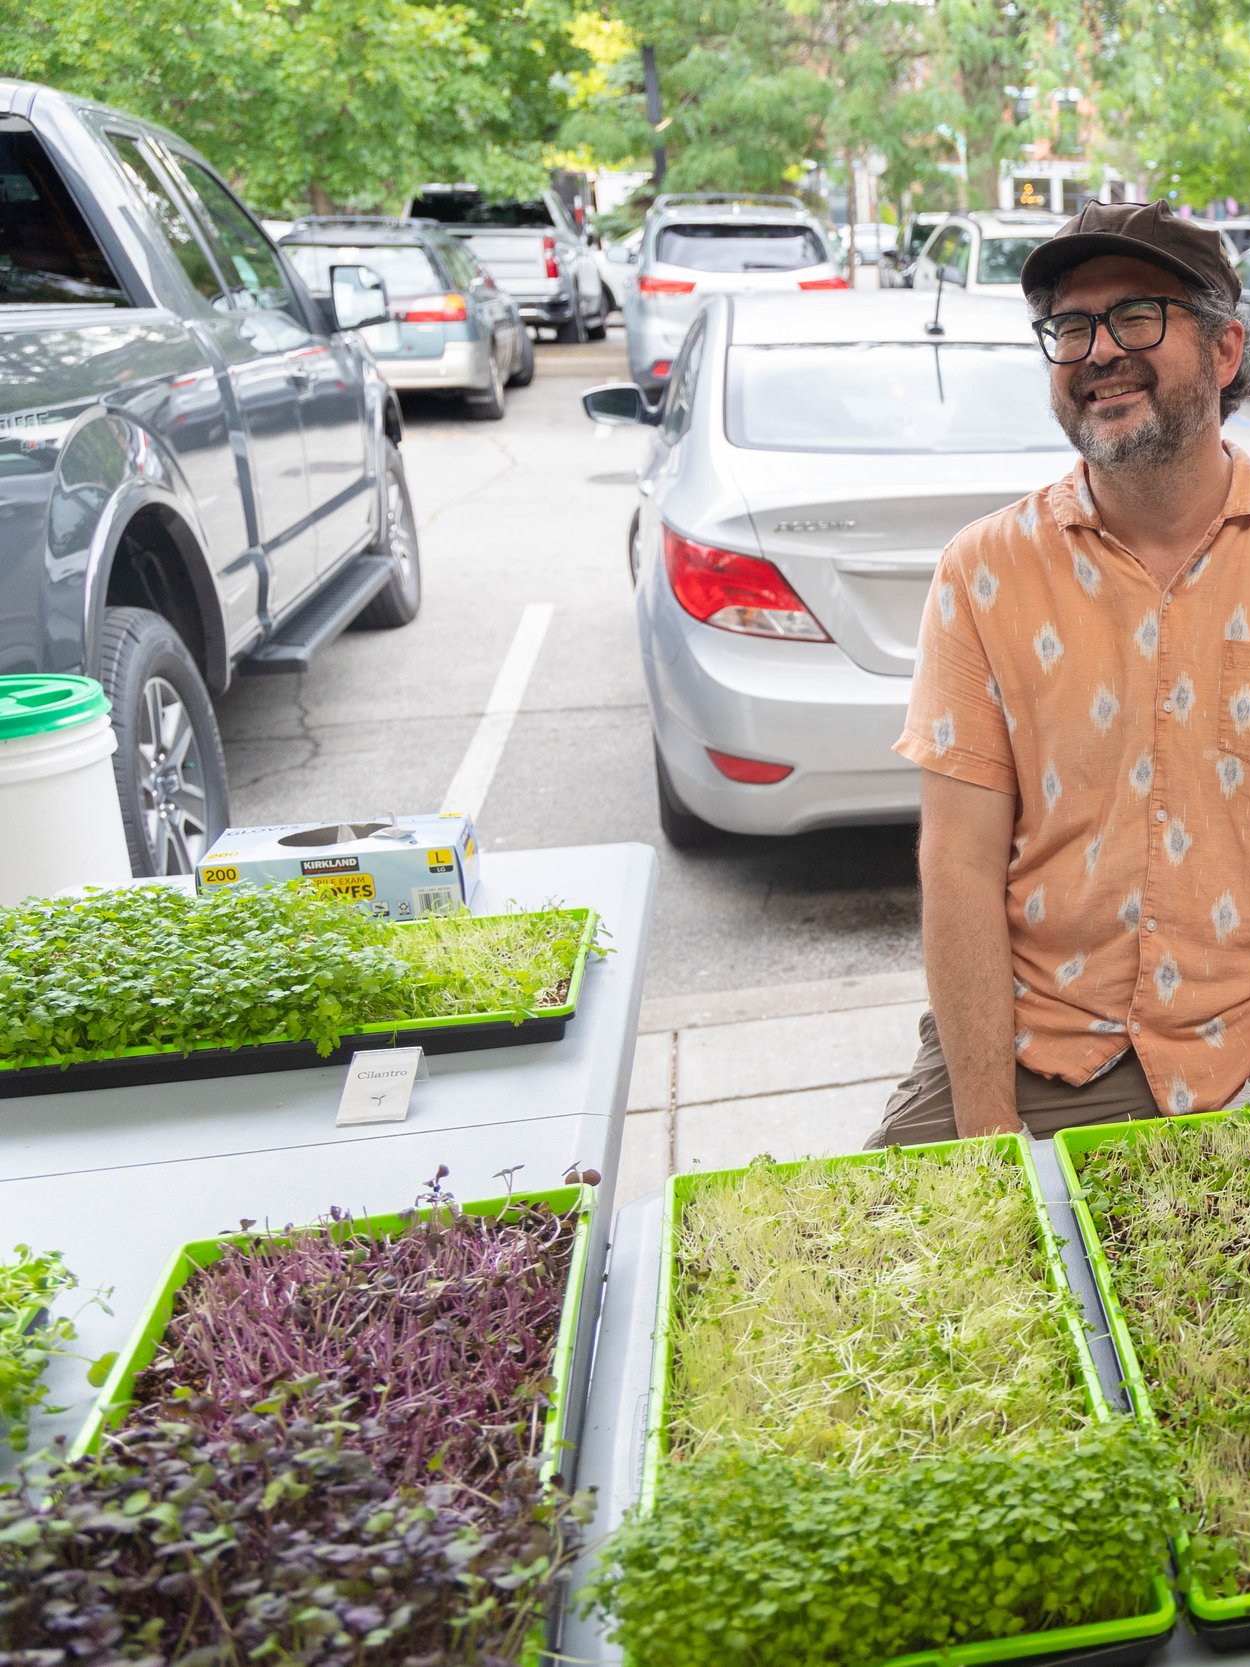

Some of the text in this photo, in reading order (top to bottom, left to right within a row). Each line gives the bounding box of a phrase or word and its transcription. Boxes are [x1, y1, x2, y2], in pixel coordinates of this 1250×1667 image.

[435, 851, 445, 864] L
[303, 858, 357, 870] KIRKLAND
[205, 868, 237, 882] 200
[339, 876, 367, 886] EXAM
[357, 1070, 408, 1080] Cilantro
